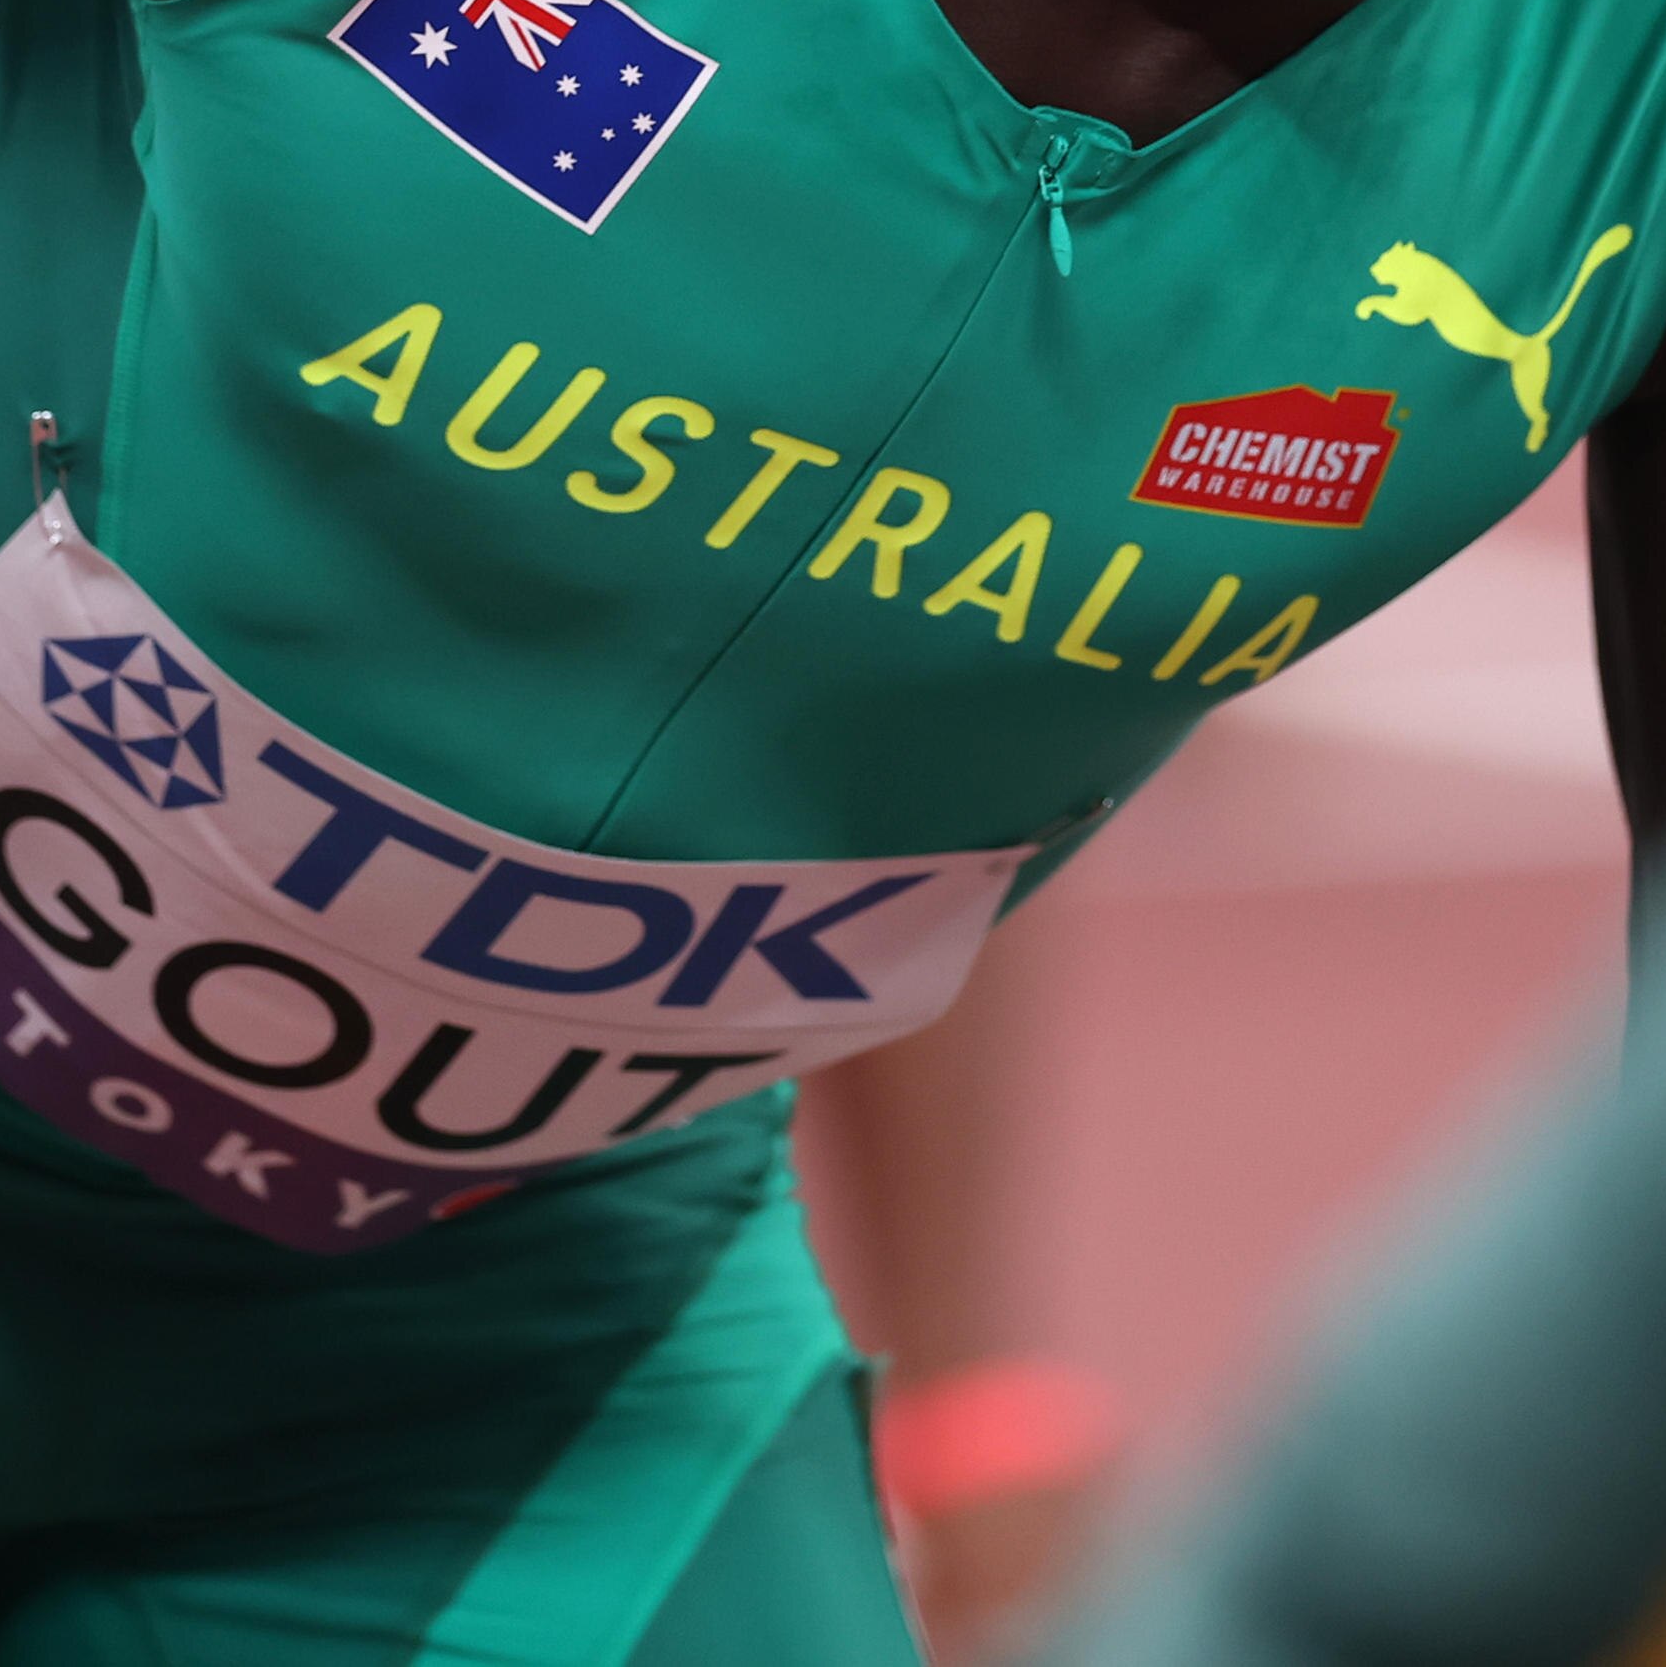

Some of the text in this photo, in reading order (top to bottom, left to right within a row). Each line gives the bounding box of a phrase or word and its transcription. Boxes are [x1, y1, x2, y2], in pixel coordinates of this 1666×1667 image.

[299, 302, 1321, 686] AUSTRALIA
[1156, 466, 1355, 511] WAREHOUSE
[1169, 422, 1381, 484] CHEMIST
[256, 740, 941, 1007] TDK
[6, 987, 523, 1229] TOKY
